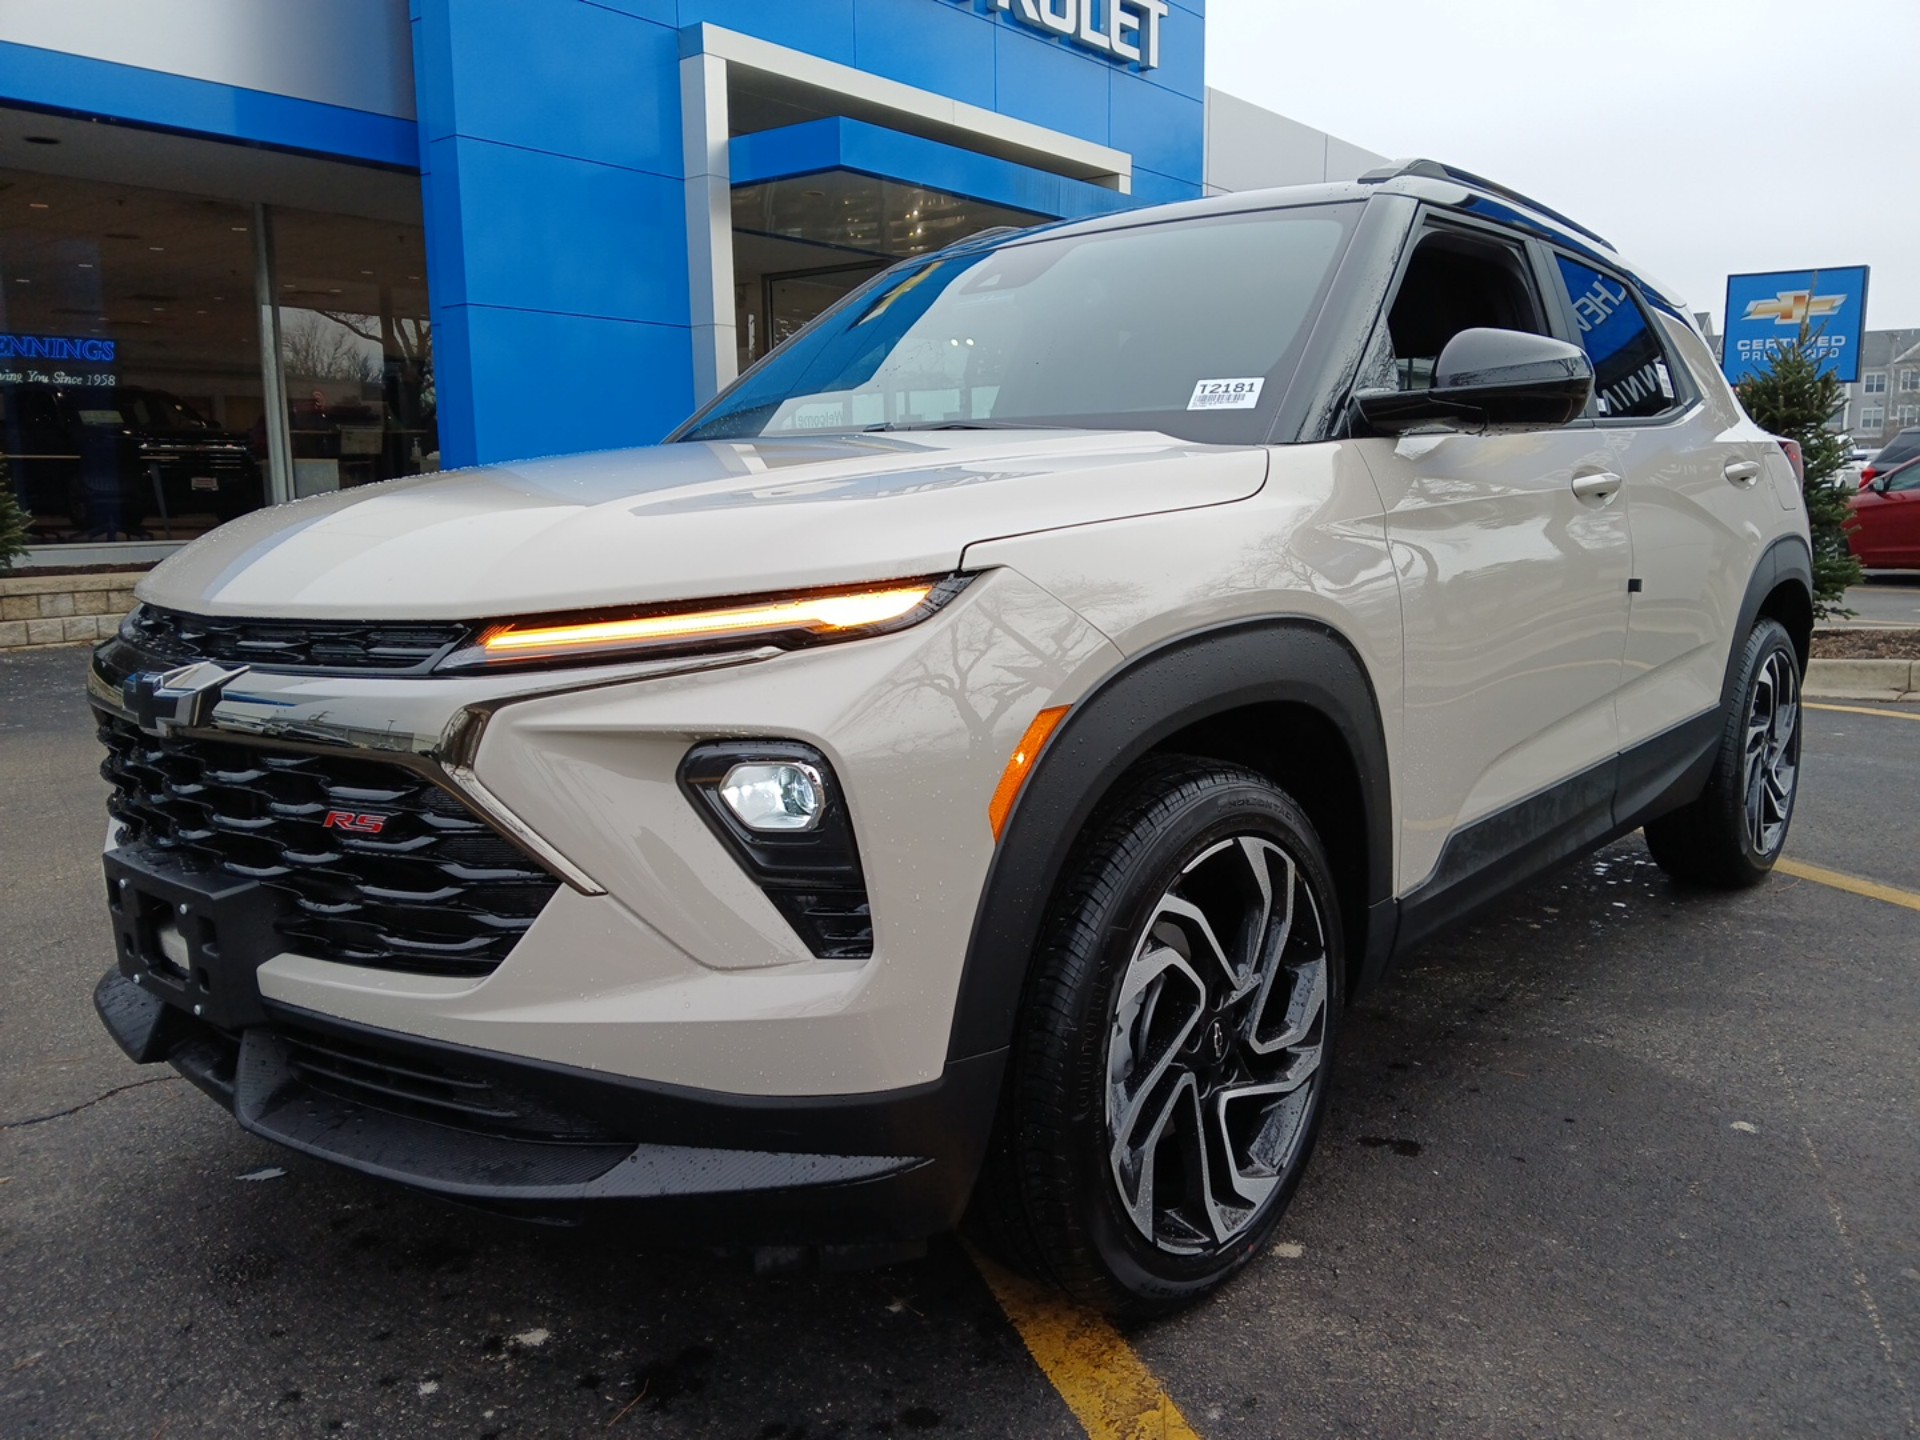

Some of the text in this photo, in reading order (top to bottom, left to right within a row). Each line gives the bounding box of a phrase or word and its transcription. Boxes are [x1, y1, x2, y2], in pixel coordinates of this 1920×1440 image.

[1737, 335, 1846, 350] CERTED
[27, 370, 49, 384] You
[53, 371, 83, 385] Since
[87, 374, 116, 386] 1958
[1200, 382, 1255, 394] T2181
[322, 811, 388, 833] RS
